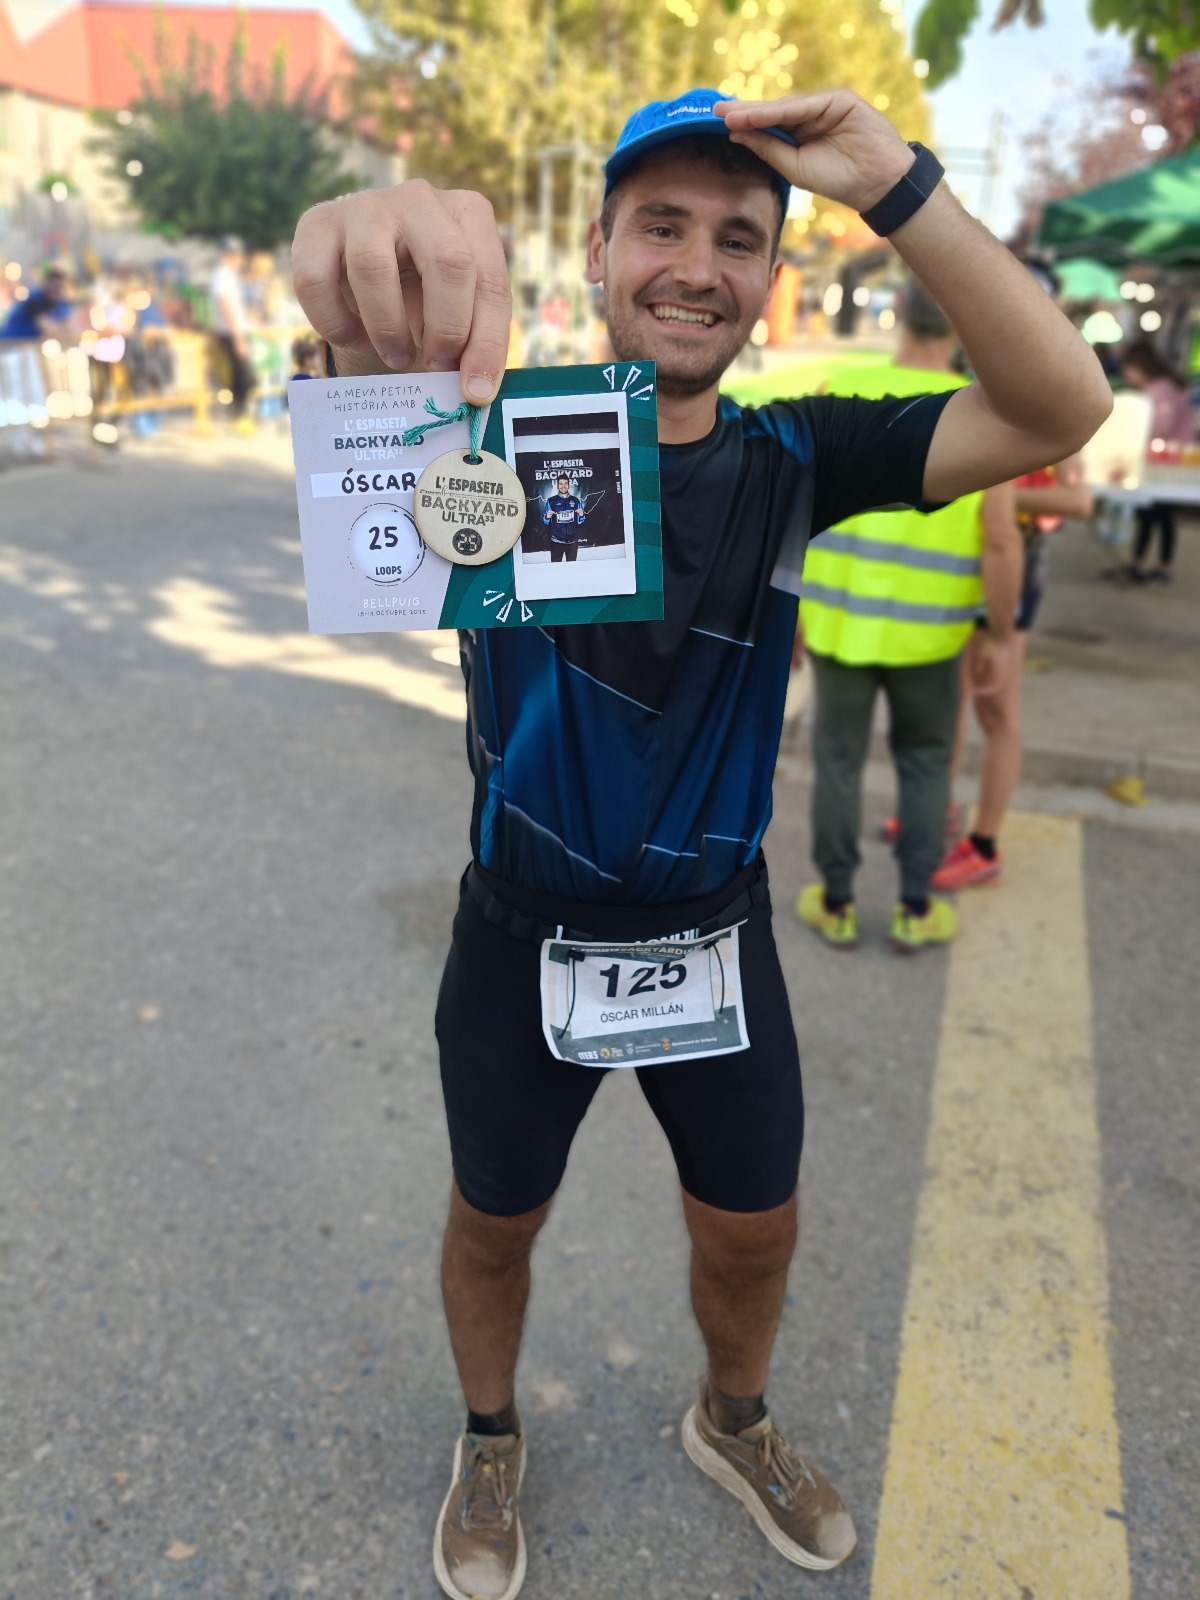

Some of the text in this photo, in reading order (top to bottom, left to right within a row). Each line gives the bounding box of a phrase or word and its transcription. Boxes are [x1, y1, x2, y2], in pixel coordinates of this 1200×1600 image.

[327, 385, 422, 399] LA MEVA PETITA
[334, 399, 416, 412] HISTÒRIA AMB
[341, 468, 416, 494] ÓSCAR
[421, 494, 519, 518] BACKYARD
[368, 526, 399, 550] 25
[457, 533, 477, 552] 25
[375, 565, 402, 576] LOOPS
[363, 597, 420, 609] BELLPUIG
[599, 962, 687, 998] 125
[600, 1002, 684, 1023] ÓSCAR MILLÁN
